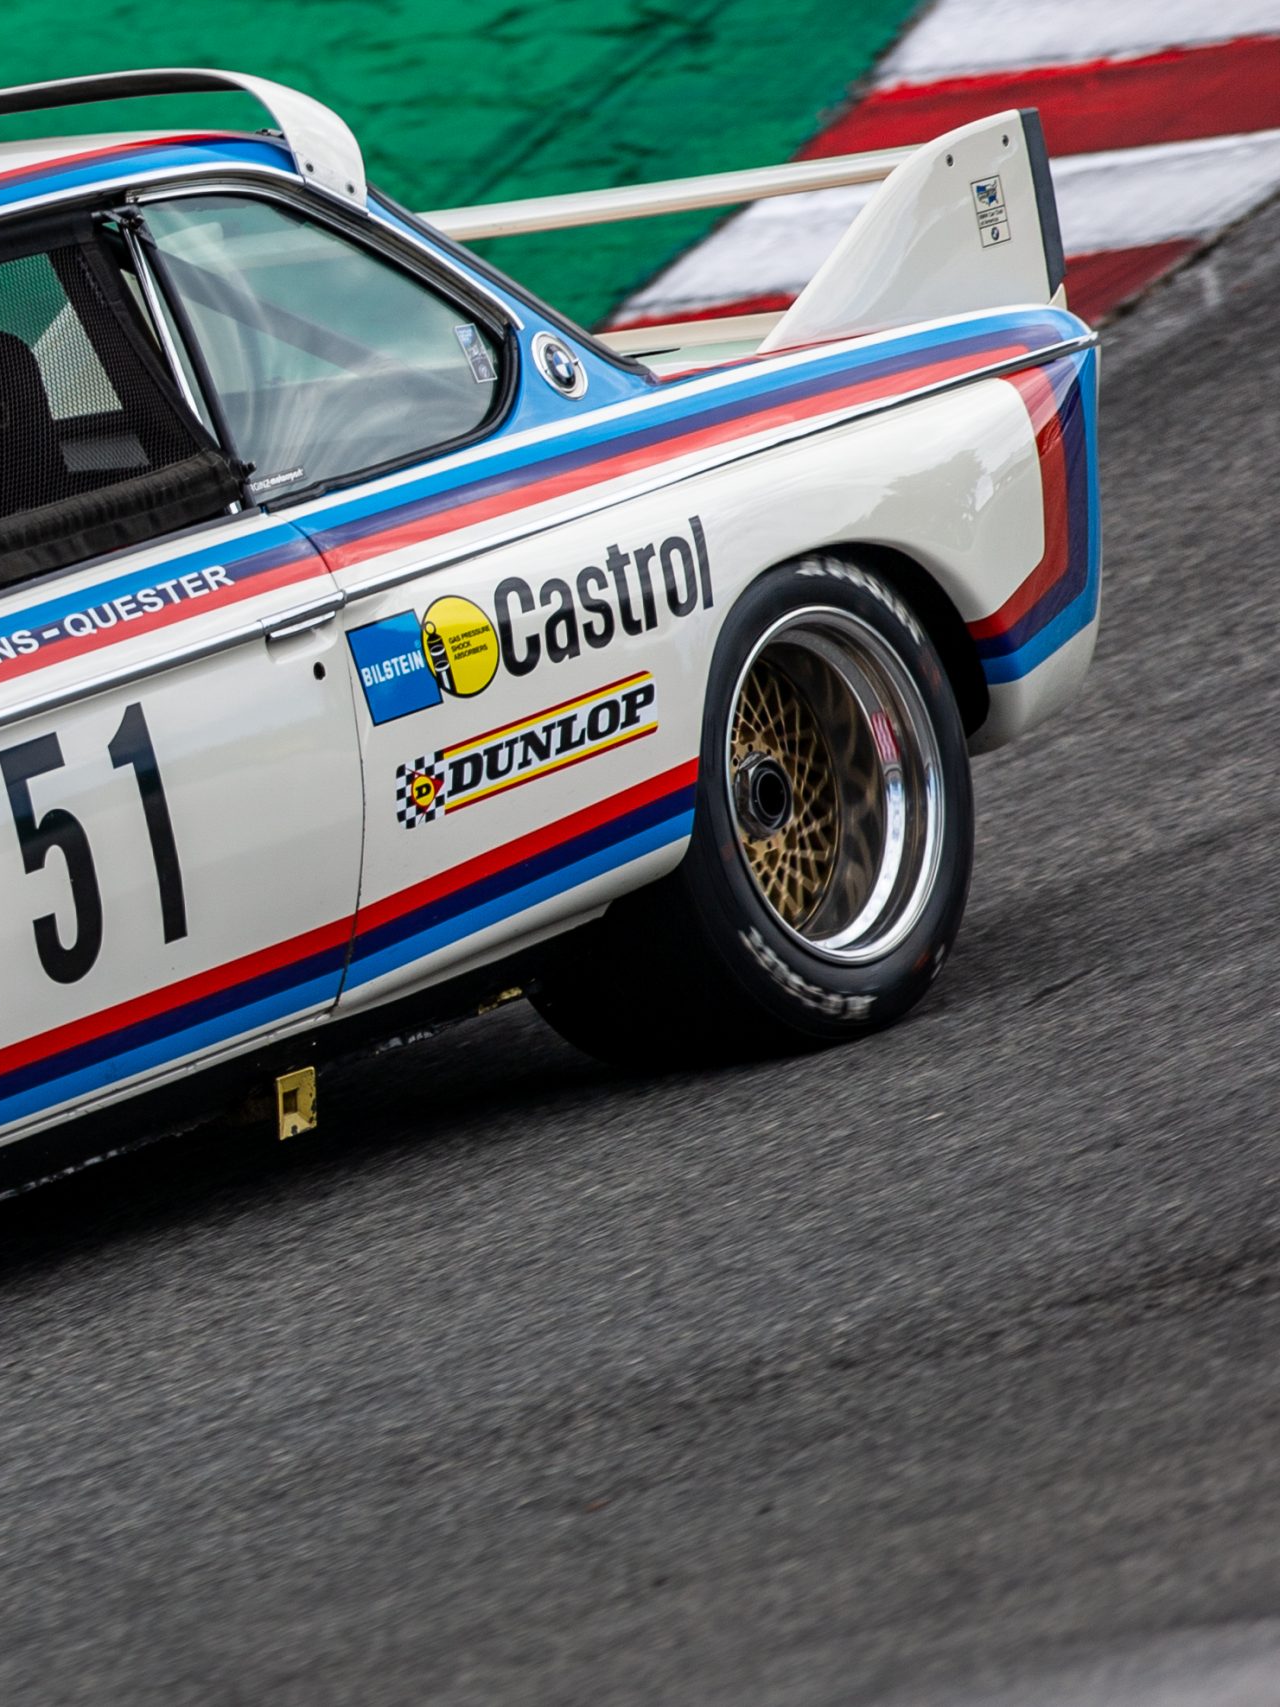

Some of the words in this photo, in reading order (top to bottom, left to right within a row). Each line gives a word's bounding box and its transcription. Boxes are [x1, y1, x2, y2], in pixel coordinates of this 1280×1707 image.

[493, 515, 714, 677] Castrol
[449, 635, 461, 643] GAS
[461, 625, 490, 638] PRESSURE
[452, 641, 470, 652] SHOCK
[361, 650, 425, 687] BILSTEIN
[446, 683, 655, 798] DUNLOP
